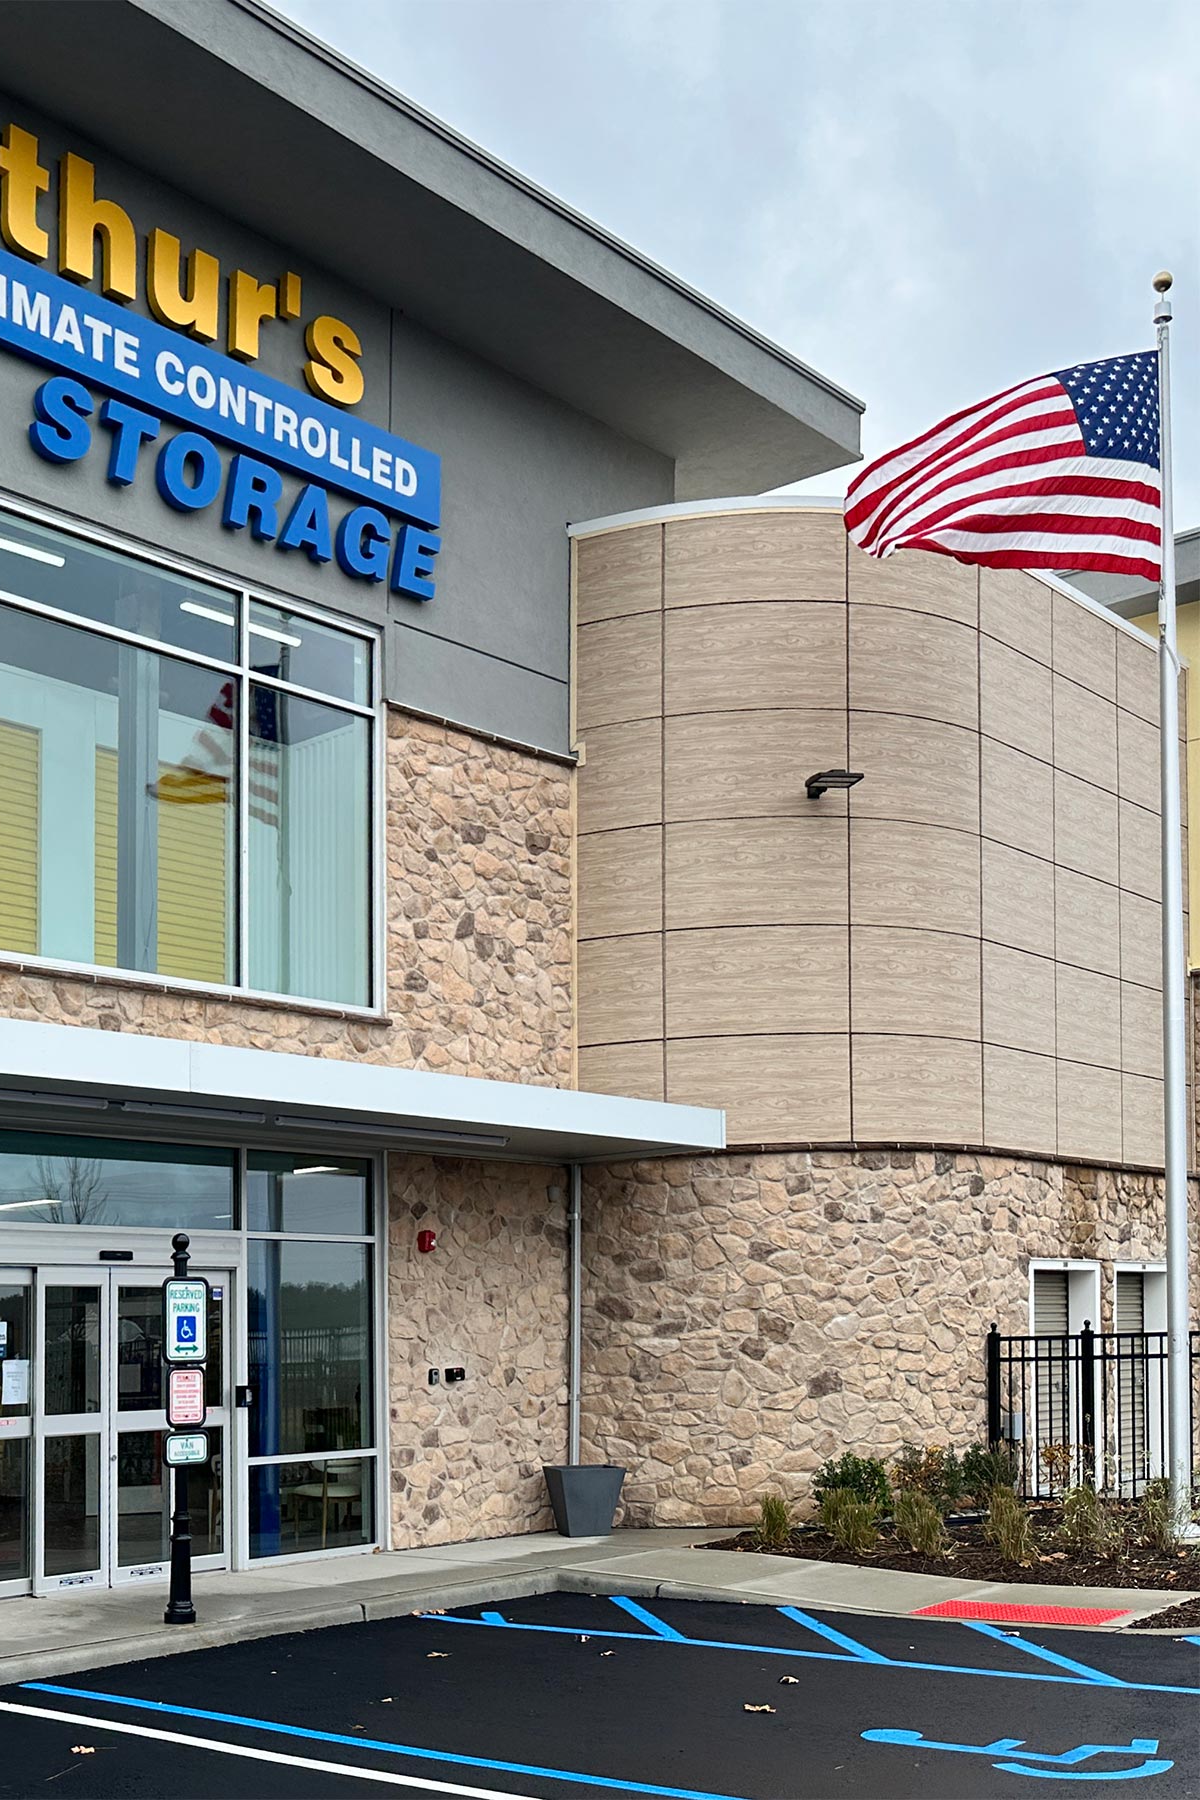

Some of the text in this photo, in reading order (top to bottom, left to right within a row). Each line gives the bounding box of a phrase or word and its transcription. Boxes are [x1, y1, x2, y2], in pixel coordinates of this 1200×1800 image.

[154, 350, 418, 497] CONTROLLED
[28, 376, 441, 602] STORAGE
[170, 1289, 203, 1300] RESERVED
[173, 1303, 200, 1313] PARKING
[180, 1441, 194, 1449] VAN
